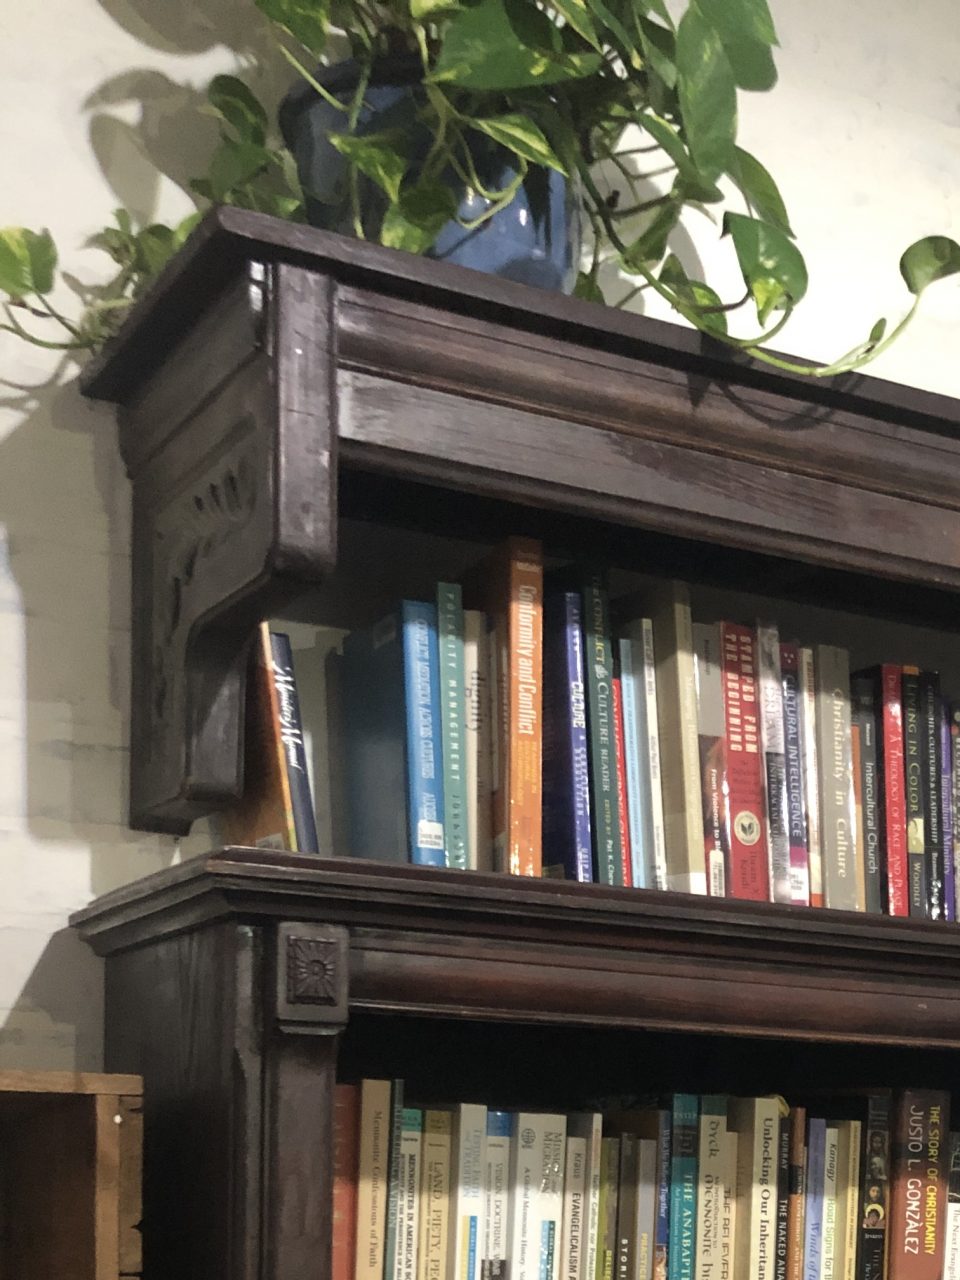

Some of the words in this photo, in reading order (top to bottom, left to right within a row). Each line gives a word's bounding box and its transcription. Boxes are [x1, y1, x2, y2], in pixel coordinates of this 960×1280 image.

[415, 618, 429, 659] CONFLICT
[445, 593, 457, 668] POLARITY
[516, 585, 536, 656] Conformity
[726, 634, 737, 661] THE
[518, 659, 533, 680] and
[739, 635, 756, 703] STAMPED
[417, 707, 433, 738] ACROSS
[518, 684, 537, 735] Conflict
[727, 673, 741, 751] BEGINNING
[785, 675, 799, 741] CULTURAL
[907, 684, 918, 733] LIVING
[449, 680, 461, 780] MANAGEMENT
[744, 716, 757, 753] FROM
[831, 689, 847, 780] Christianity
[909, 740, 918, 754] IN
[420, 740, 435, 779] CULTURES
[788, 745, 803, 836] INTELLIGENCE
[835, 791, 847, 805] in
[865, 762, 876, 829] Intercultural
[910, 763, 920, 811] COLOR
[835, 819, 849, 877] Culture
[868, 833, 877, 873] Church
[907, 1105, 924, 1152] JUSTO
[928, 1106, 940, 1126] THE
[371, 1110, 382, 1163] Mennonite
[759, 1118, 773, 1185] Unlocking
[927, 1130, 940, 1163] STORY
[573, 1153, 582, 1179] Kraus
[826, 1144, 837, 1181] Kanagy
[907, 1159, 920, 1171] L.
[927, 1168, 938, 1181] OF
[370, 1166, 381, 1226] Confessions
[683, 1174, 693, 1201] THE
[760, 1189, 770, 1216] Our
[779, 1200, 788, 1218] THE
[826, 1198, 835, 1223] Road
[924, 1185, 937, 1255] CHRISTIANITY
[952, 1209, 960, 1222] The
[369, 1229, 379, 1239] of
[570, 1193, 581, 1273] EVANGELICALISM
[778, 1222, 787, 1257] NAKED
[808, 1221, 821, 1258] Winds
[824, 1227, 834, 1254] Signs
[951, 1226, 959, 1241] Next
[368, 1241, 378, 1268] Faith
[806, 1260, 818, 1272] of
[824, 1257, 833, 1271] for
